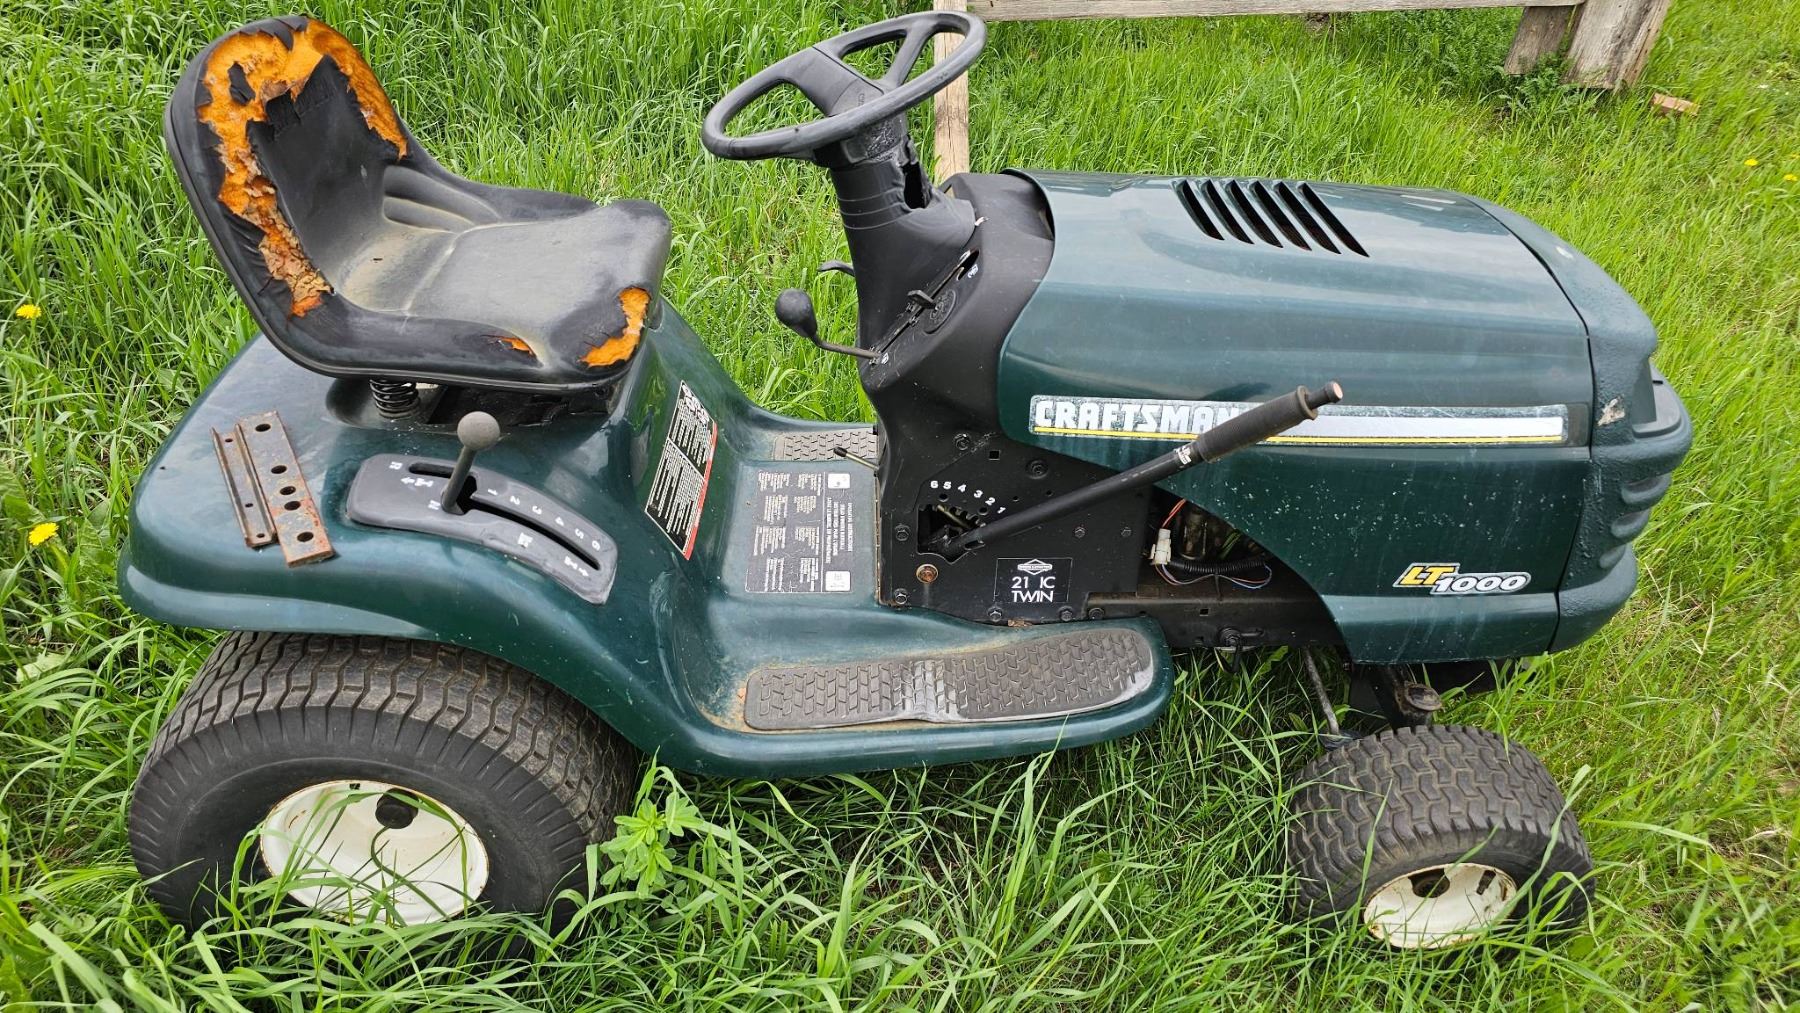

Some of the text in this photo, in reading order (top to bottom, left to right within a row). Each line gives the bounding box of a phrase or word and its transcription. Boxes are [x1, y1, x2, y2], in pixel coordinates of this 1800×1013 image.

[389, 461, 403, 470] R
[930, 480, 1006, 514] 6 5 4 3 2 1
[487, 488, 601, 551] 1 2 3 4 5 6
[1011, 576, 1029, 589] 21
[1400, 565, 1457, 586] LT
[1433, 575, 1528, 593] 1000
[1011, 590, 1054, 603] TWIN
